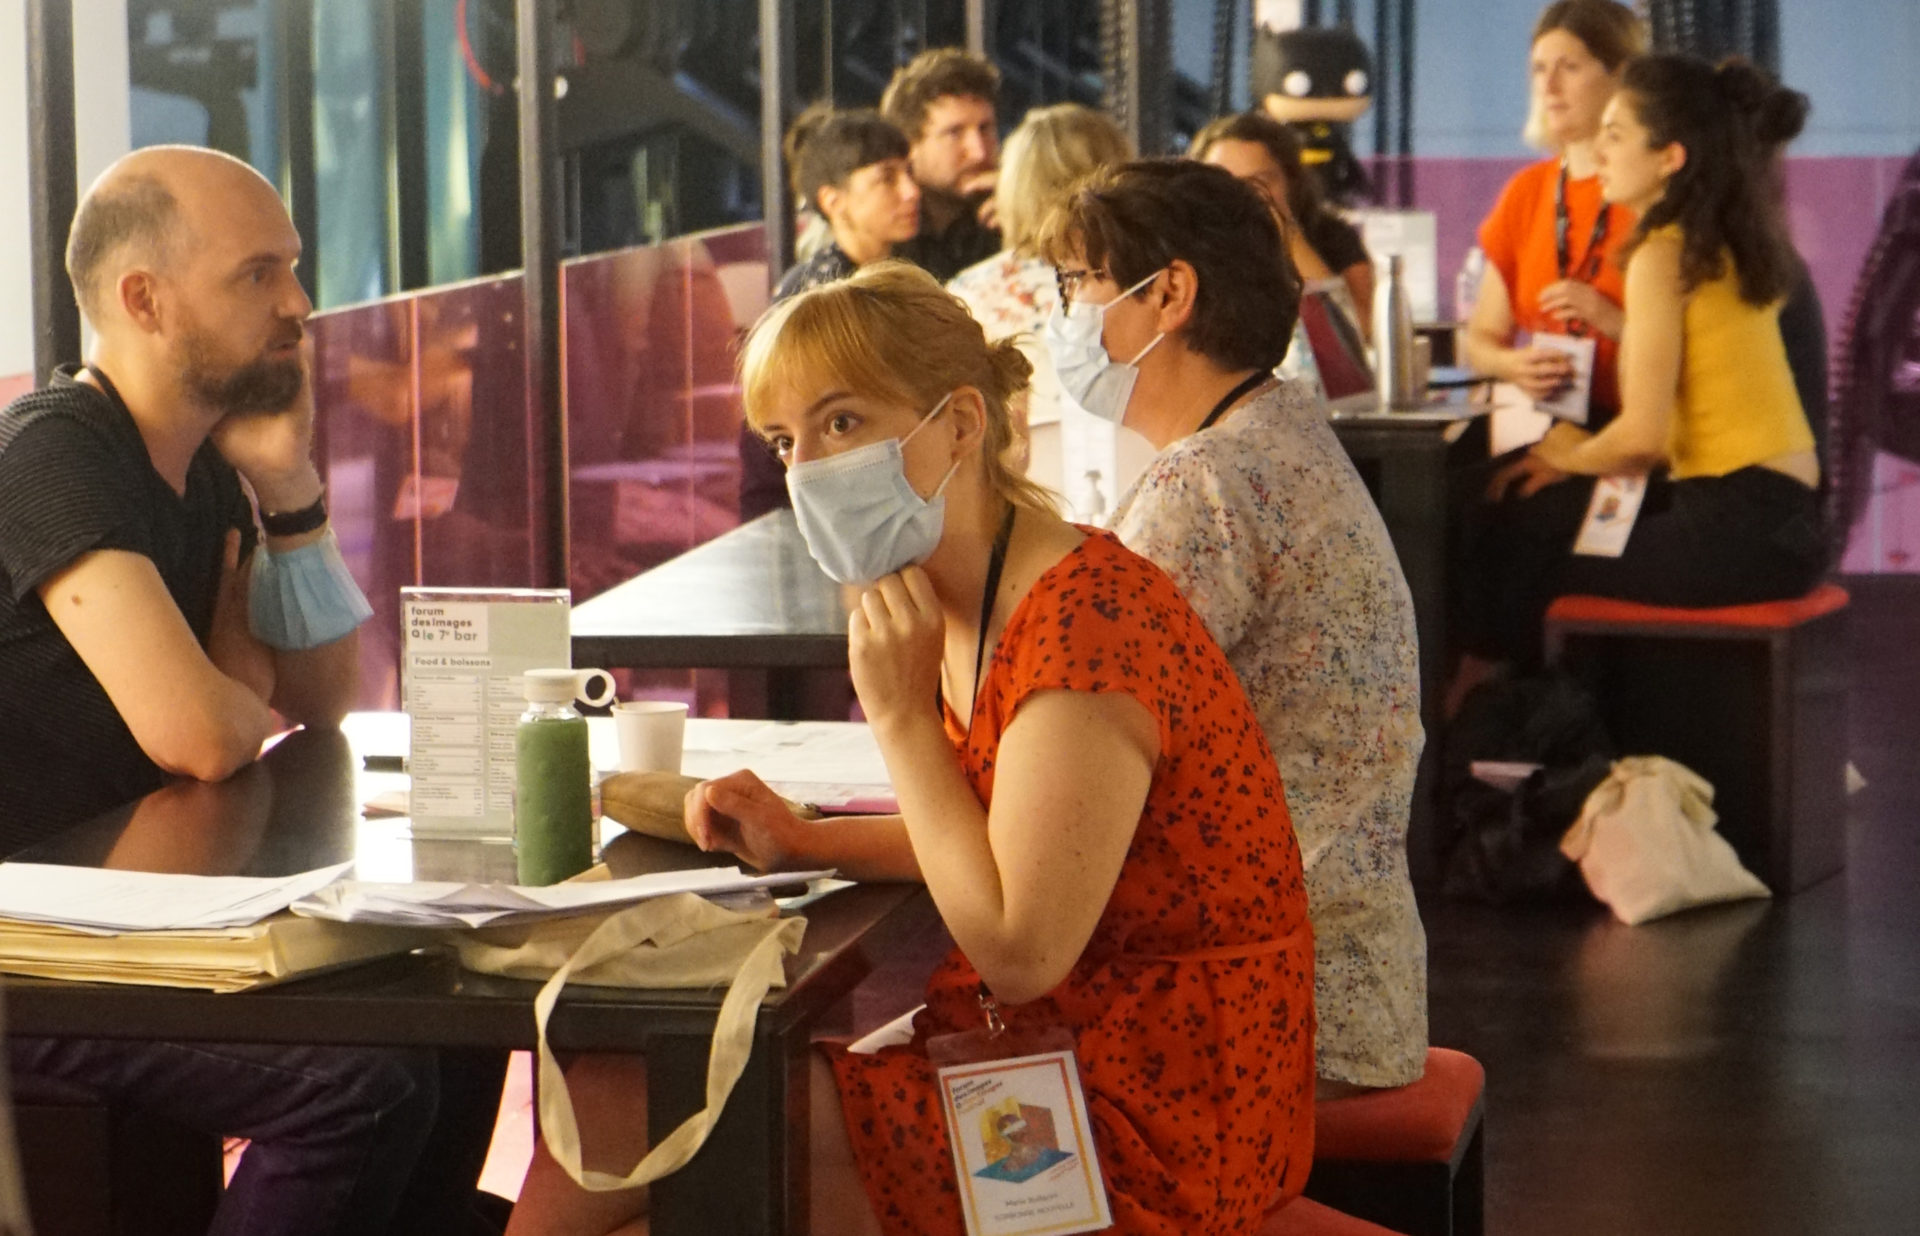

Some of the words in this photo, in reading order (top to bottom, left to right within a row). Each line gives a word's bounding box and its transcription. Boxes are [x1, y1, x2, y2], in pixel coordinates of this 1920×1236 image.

[411, 606, 445, 616] forum
[454, 630, 478, 641] bar
[415, 657, 439, 666] Food
[441, 657, 448, 666] &
[450, 658, 491, 667] boissons
